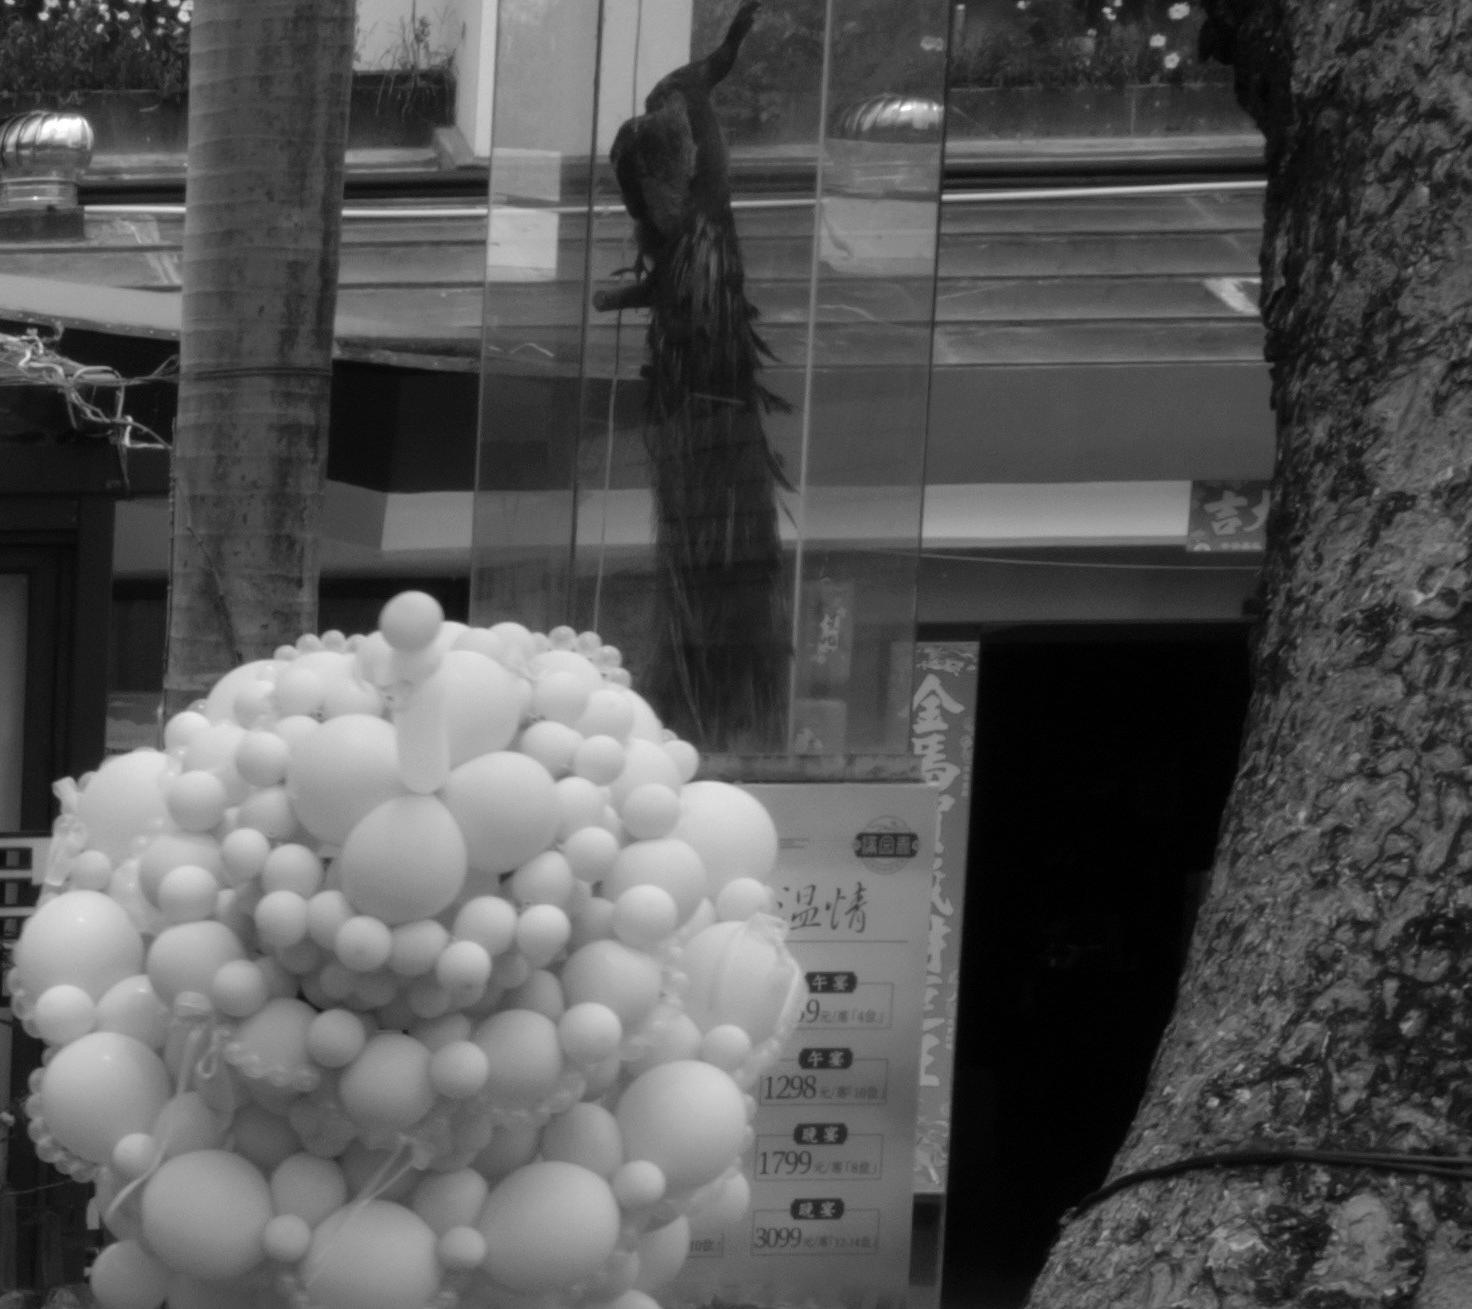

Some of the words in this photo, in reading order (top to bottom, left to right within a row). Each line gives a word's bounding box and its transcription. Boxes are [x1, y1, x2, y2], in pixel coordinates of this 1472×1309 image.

[764, 1076, 817, 1101] 1298
[759, 1150, 812, 1175] 1799
[755, 1227, 802, 1249] 3099
